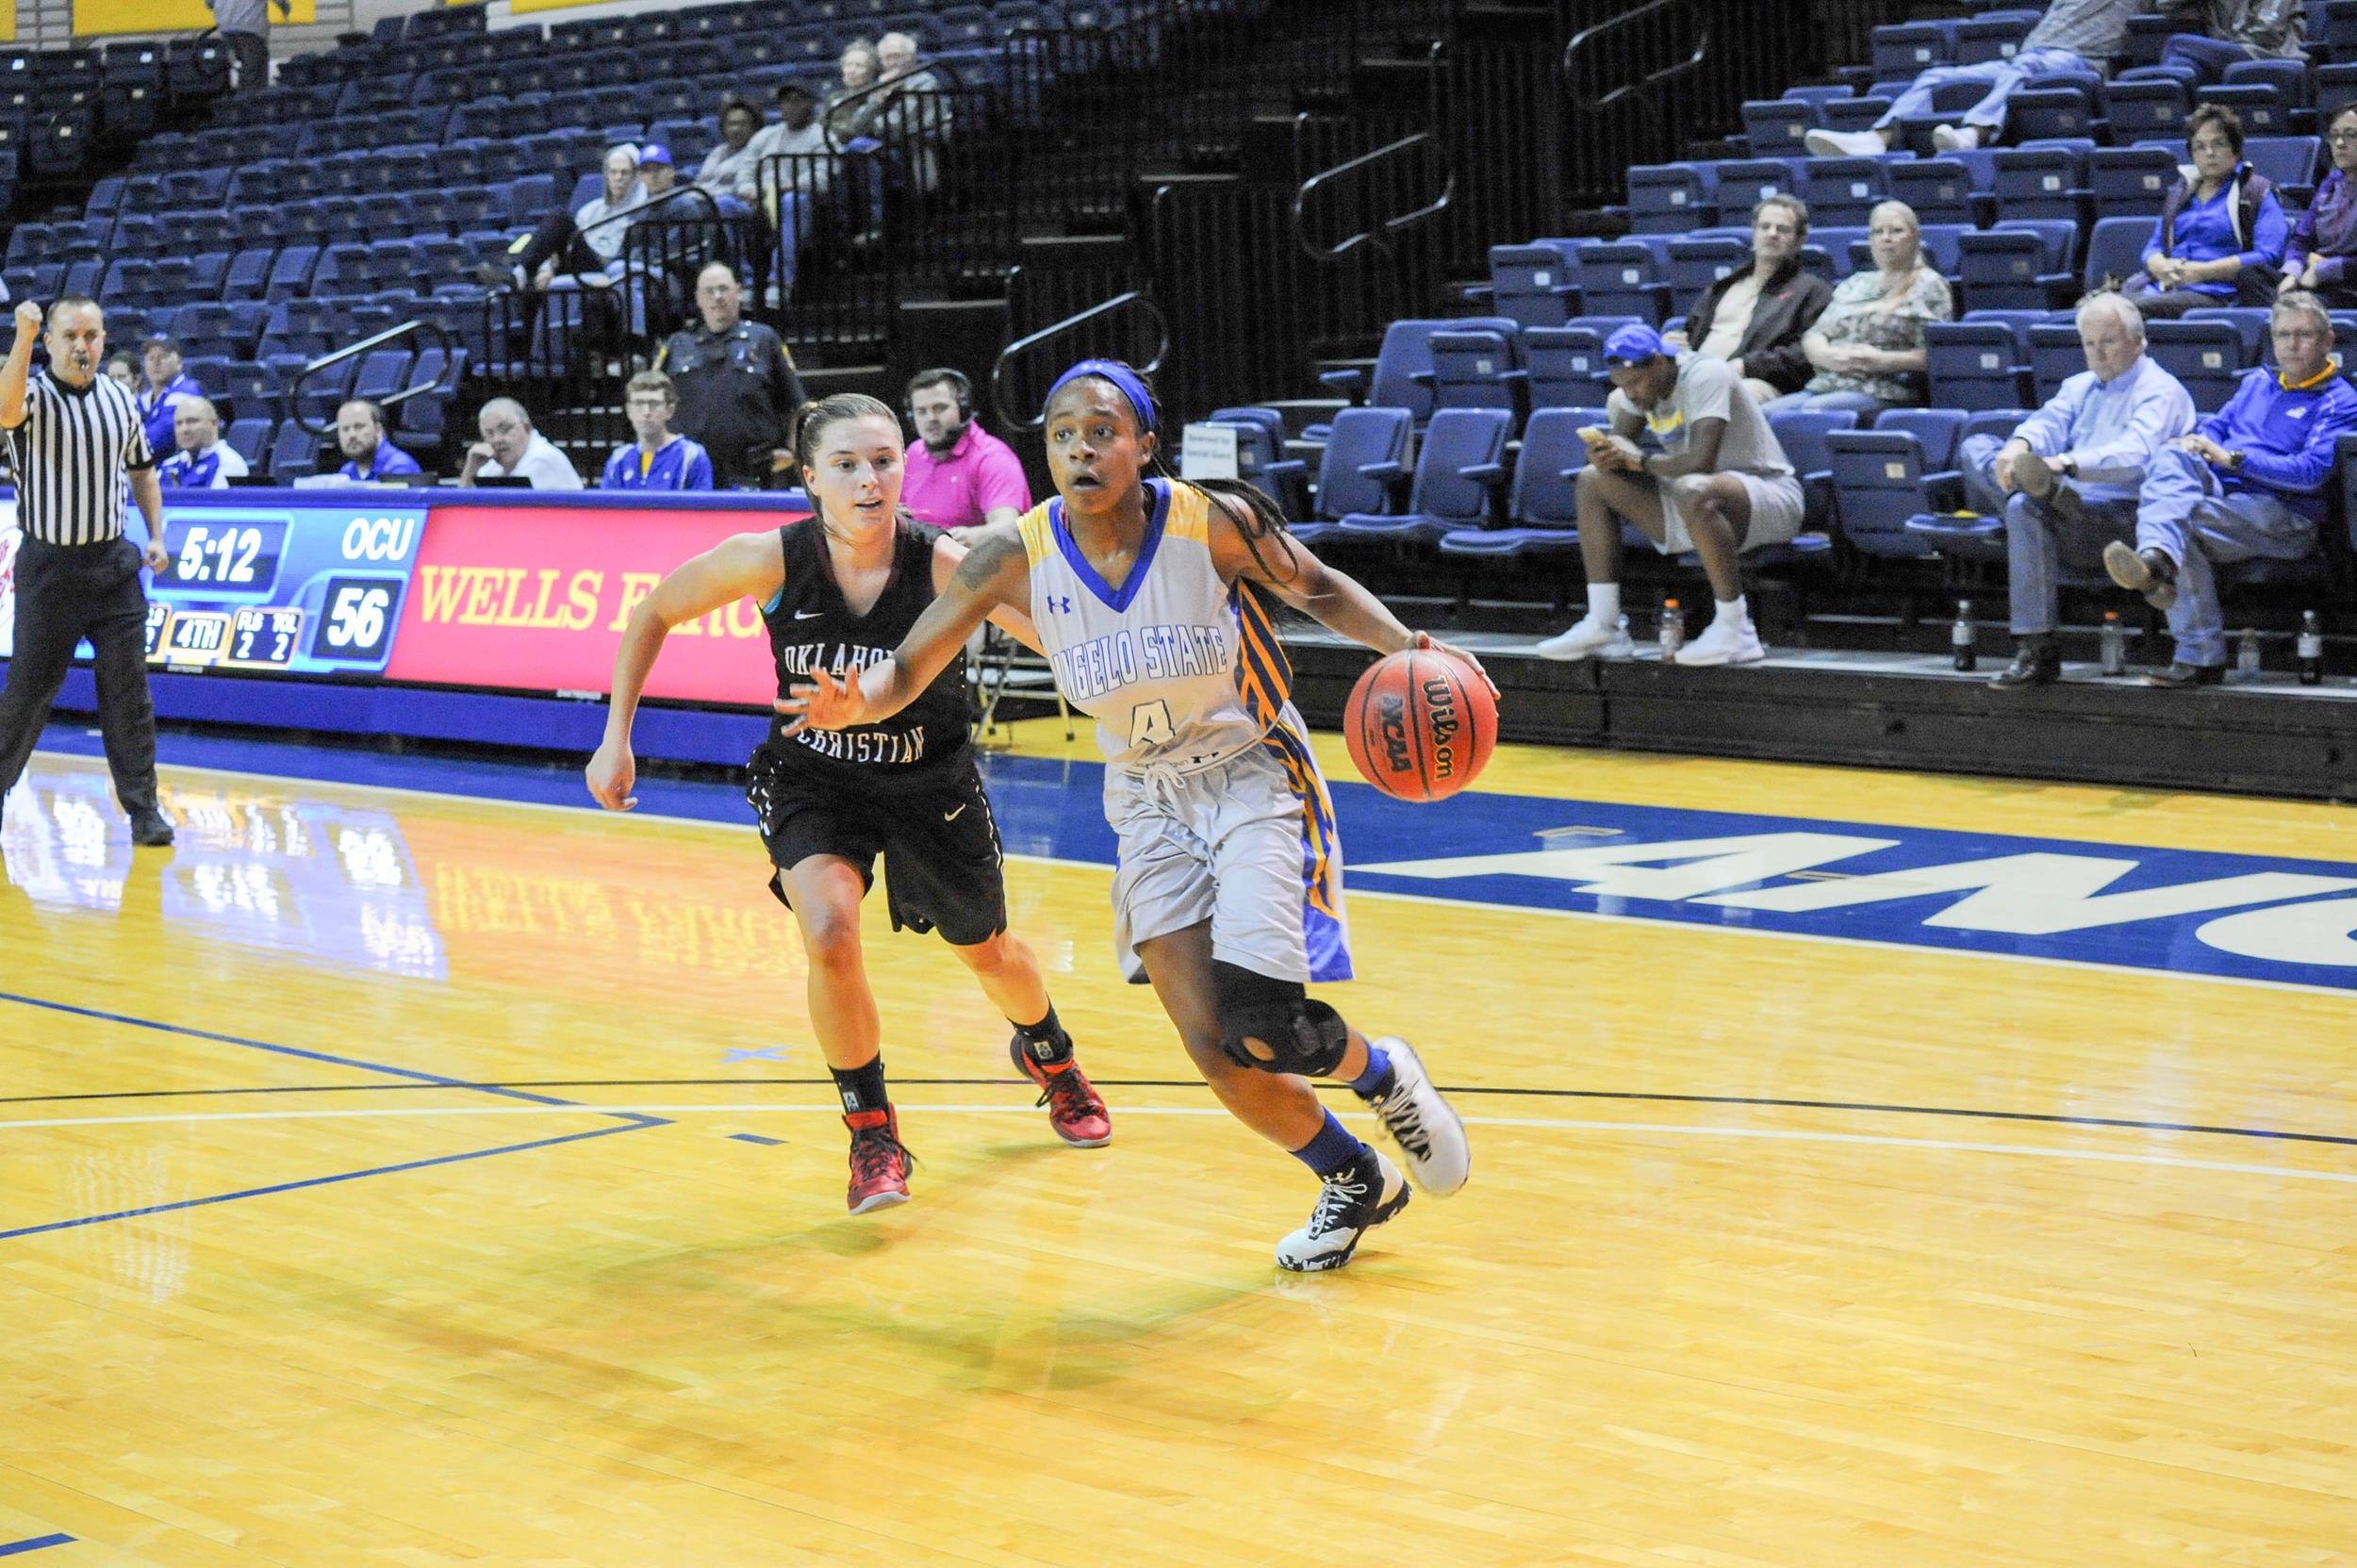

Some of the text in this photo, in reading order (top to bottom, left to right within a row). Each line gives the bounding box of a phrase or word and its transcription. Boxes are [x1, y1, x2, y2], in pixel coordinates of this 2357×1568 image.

[177, 527, 262, 583] 5:12
[342, 518, 415, 561] OCU
[327, 587, 389, 649] 56
[420, 565, 603, 632] WELLS
[175, 619, 223, 649] 4TH
[236, 631, 289, 661] 2 2
[1139, 624, 1228, 680] STATE
[1381, 694, 1413, 772] NCAA
[1422, 674, 1459, 782] Wilson
